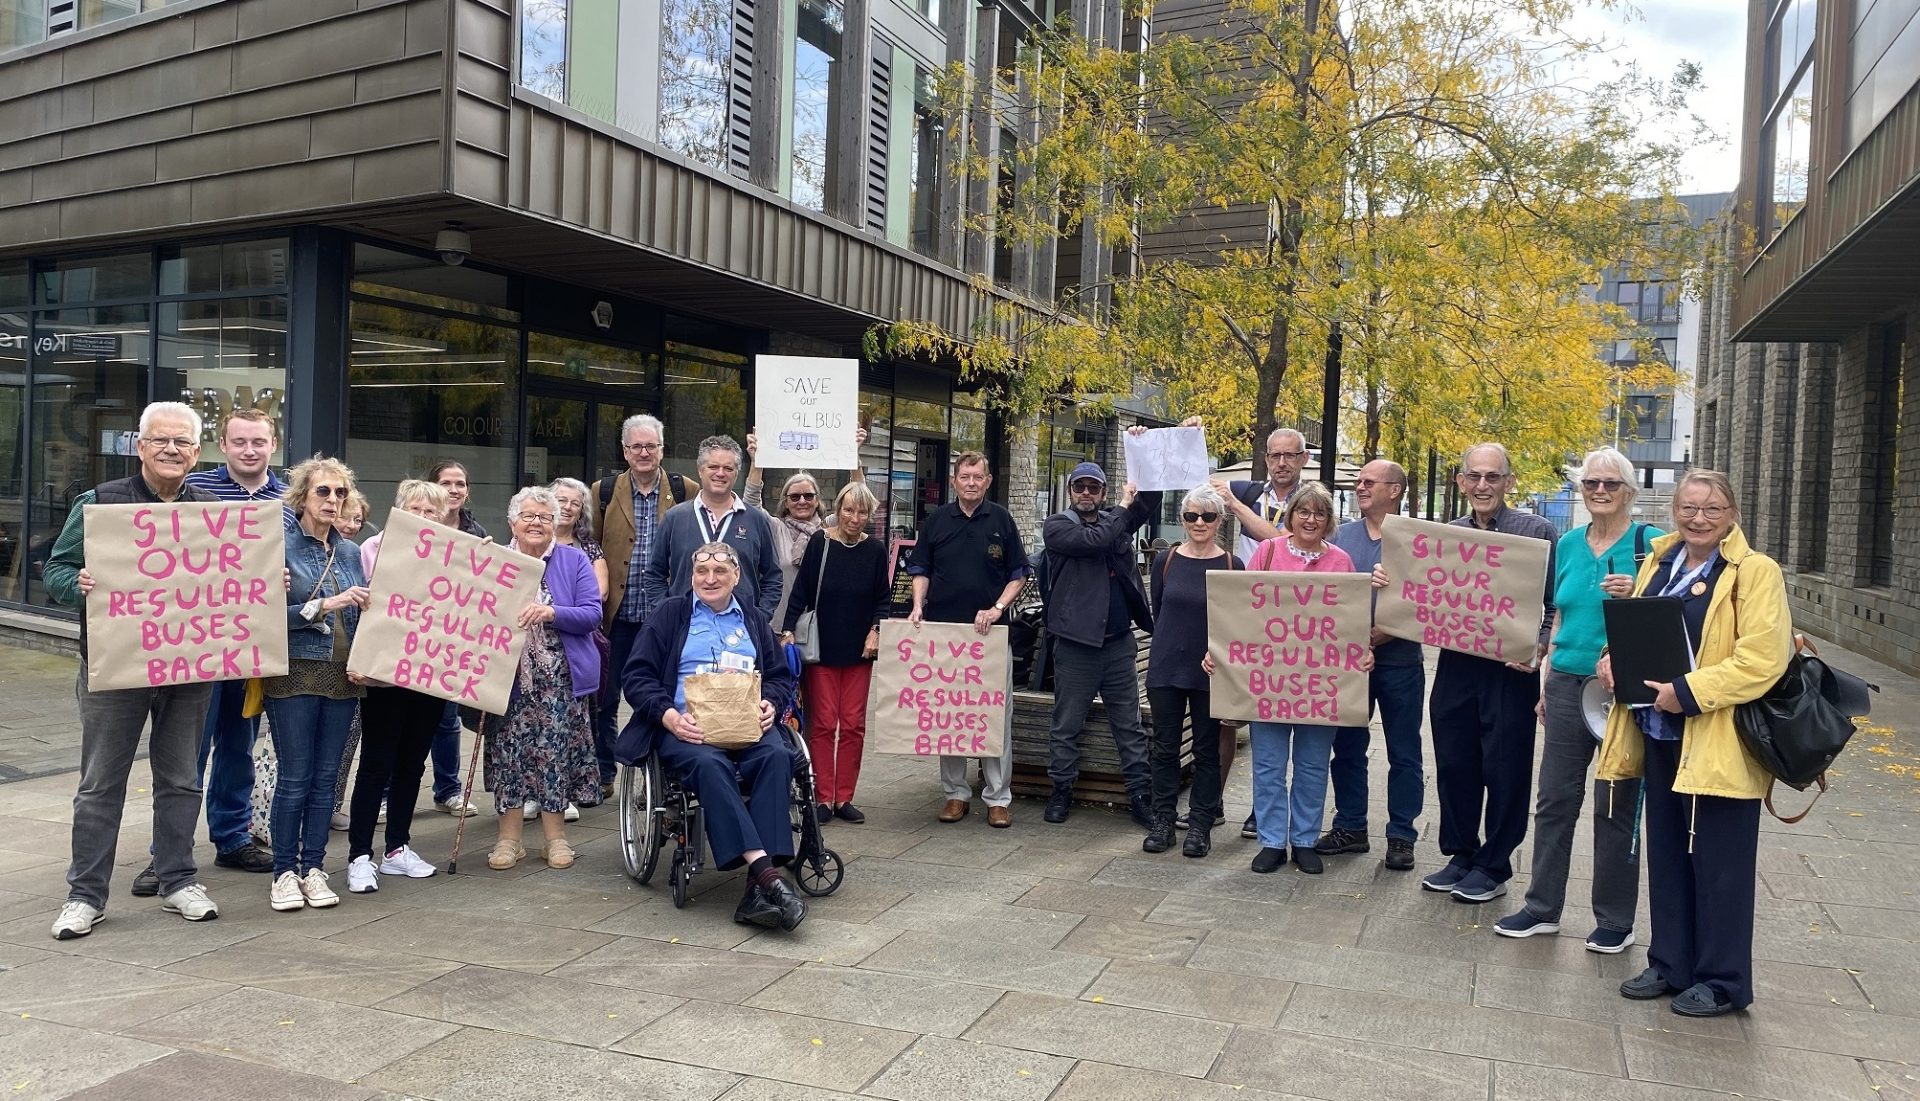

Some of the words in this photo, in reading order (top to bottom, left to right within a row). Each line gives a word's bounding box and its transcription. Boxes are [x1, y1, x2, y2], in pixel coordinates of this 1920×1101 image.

[783, 377, 832, 395] SAVE
[443, 416, 503, 436] COLOUR
[535, 418, 573, 438] AREA
[815, 412, 842, 429] BUS
[138, 542, 243, 580] OUR
[1426, 566, 1491, 591] OUR
[429, 576, 497, 617] OUR
[141, 613, 251, 651] BUSES
[1264, 614, 1338, 643] OUR
[1415, 605, 1496, 637] BUSES
[404, 631, 489, 675] BUSES
[1423, 626, 1504, 659] BACK!
[147, 645, 262, 686] BACK!
[394, 658, 481, 701] BACK
[909, 663, 983, 685] OUR
[1249, 668, 1338, 697] BUSES
[917, 707, 988, 733] BUSES
[1257, 697, 1339, 722] BACK!
[914, 733, 986, 756] BACK
